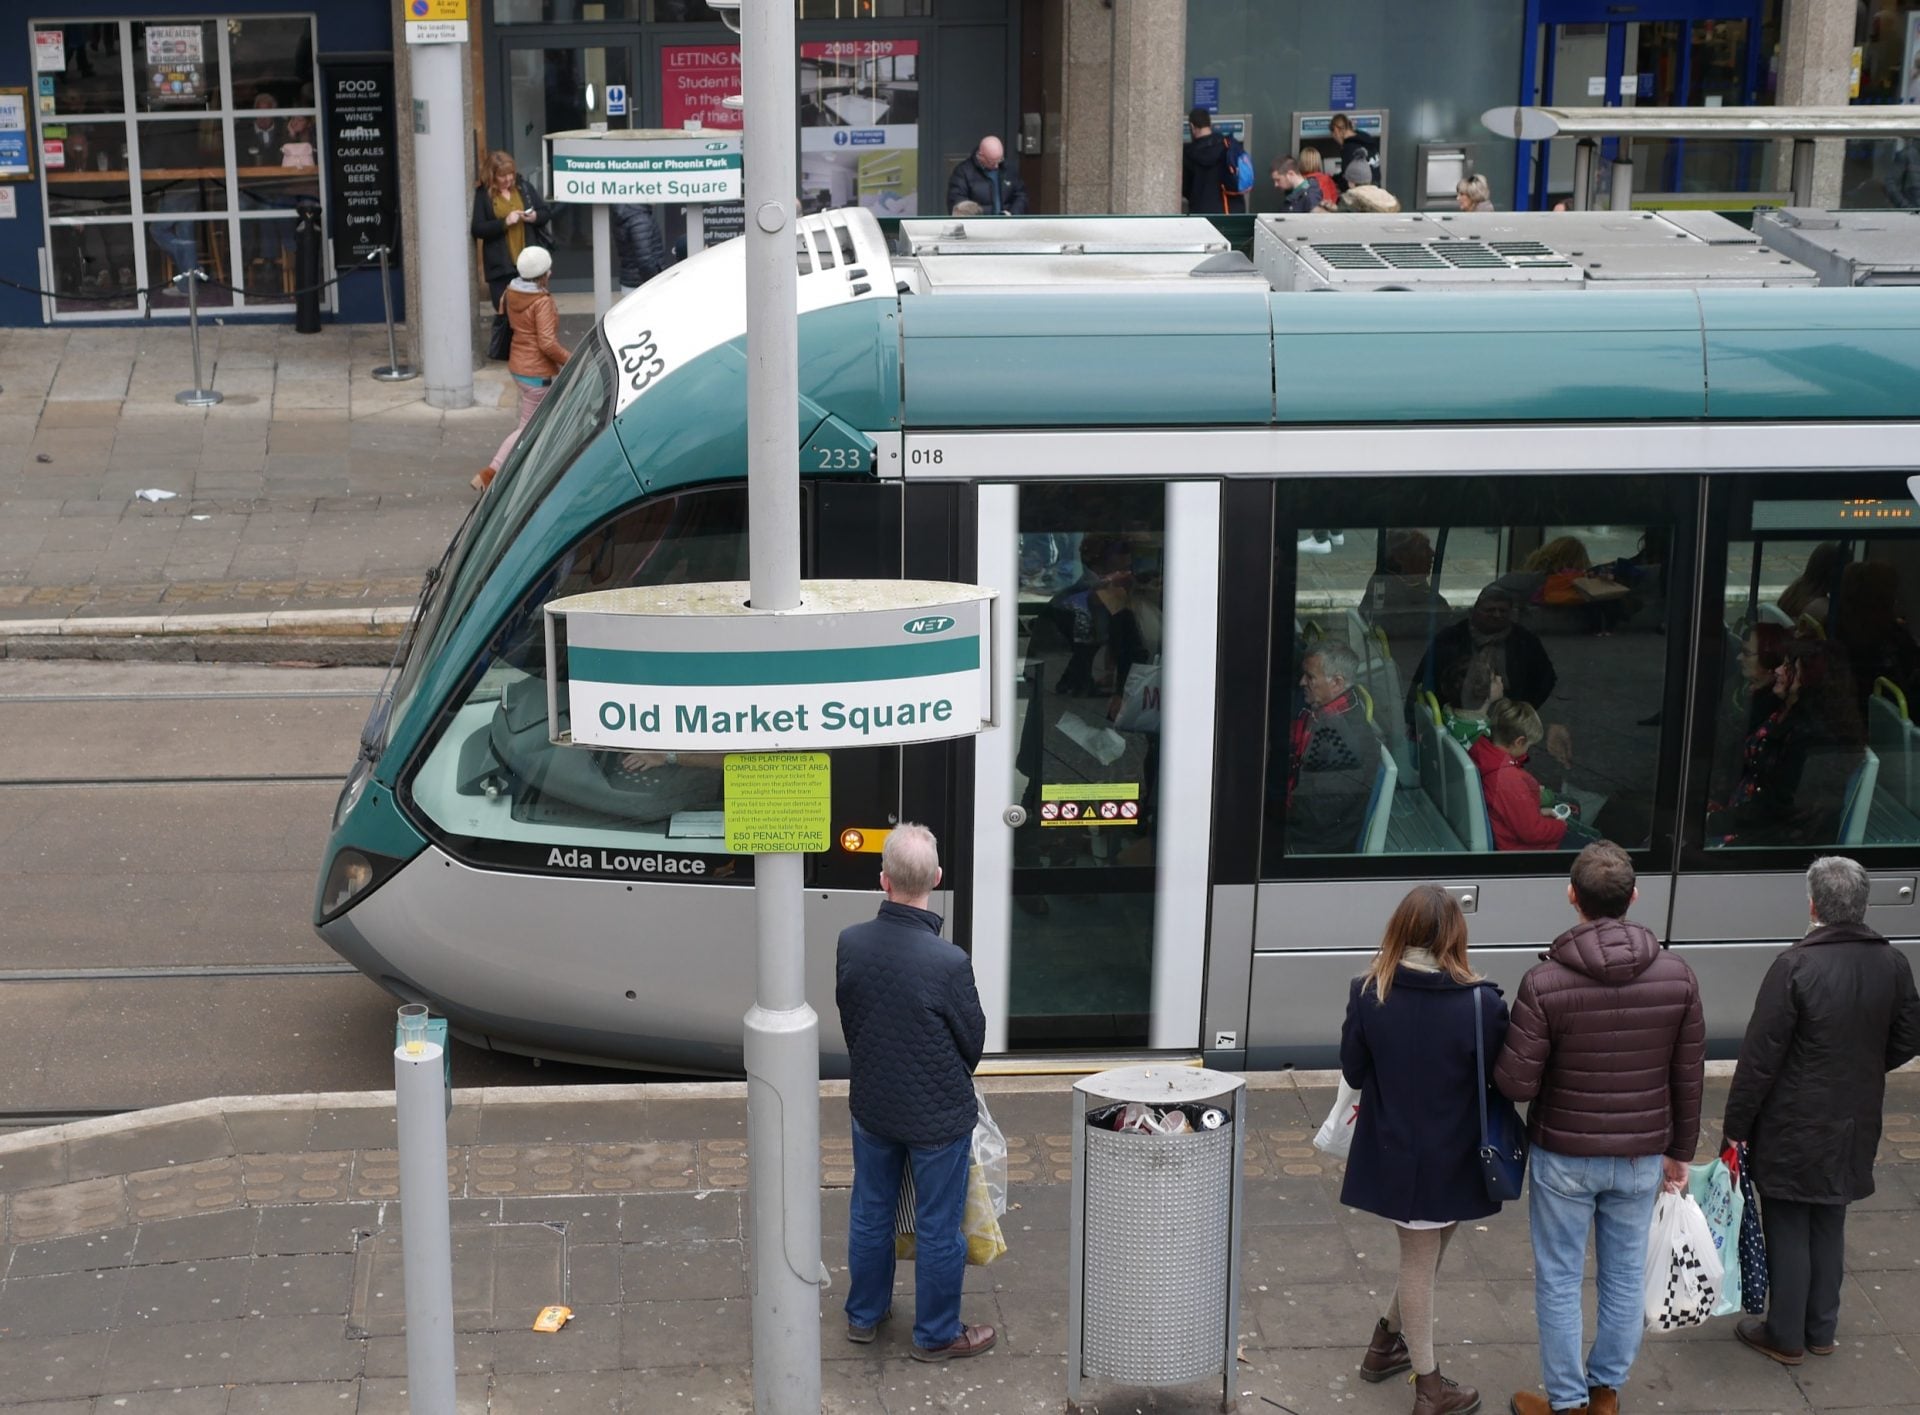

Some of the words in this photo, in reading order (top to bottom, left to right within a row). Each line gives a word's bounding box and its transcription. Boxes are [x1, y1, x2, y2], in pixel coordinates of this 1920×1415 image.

[825, 43, 854, 55] 2018
[864, 42, 893, 54] 2019
[670, 52, 728, 66] LETTING
[338, 80, 377, 92] FOOD
[677, 75, 729, 89] Student
[684, 93, 697, 106] in
[700, 92, 721, 105] the
[344, 112, 374, 121] WINES
[691, 110, 705, 121] of
[707, 110, 728, 122] the
[337, 147, 360, 157] CASK
[362, 147, 384, 156] ALES
[343, 163, 379, 173] GLOBAL
[566, 159, 606, 169] Towards
[607, 160, 650, 169] Hucknall
[652, 161, 663, 169] or
[664, 158, 704, 169] Phoenix
[706, 157, 728, 168] Park
[348, 174, 376, 183] BEERS
[567, 180, 595, 195] Old
[601, 181, 662, 195] Market
[668, 180, 728, 197] Square
[347, 197, 379, 206] SPIRITS
[703, 216, 743, 225] Insurance
[618, 329, 665, 391] 233
[819, 448, 860, 469] 233
[911, 449, 943, 464] 018
[911, 617, 948, 632] NET
[598, 701, 661, 732] Old
[675, 704, 809, 733] Market
[820, 698, 953, 735] Square
[808, 763, 829, 771] AREA
[733, 832, 750, 840] £50
[753, 832, 796, 840] PENALTY
[798, 831, 823, 839] FARE
[733, 843, 748, 851] OR
[751, 842, 823, 851] PROSECUTION
[546, 848, 593, 869] Ada
[601, 851, 706, 875] Lovelace
